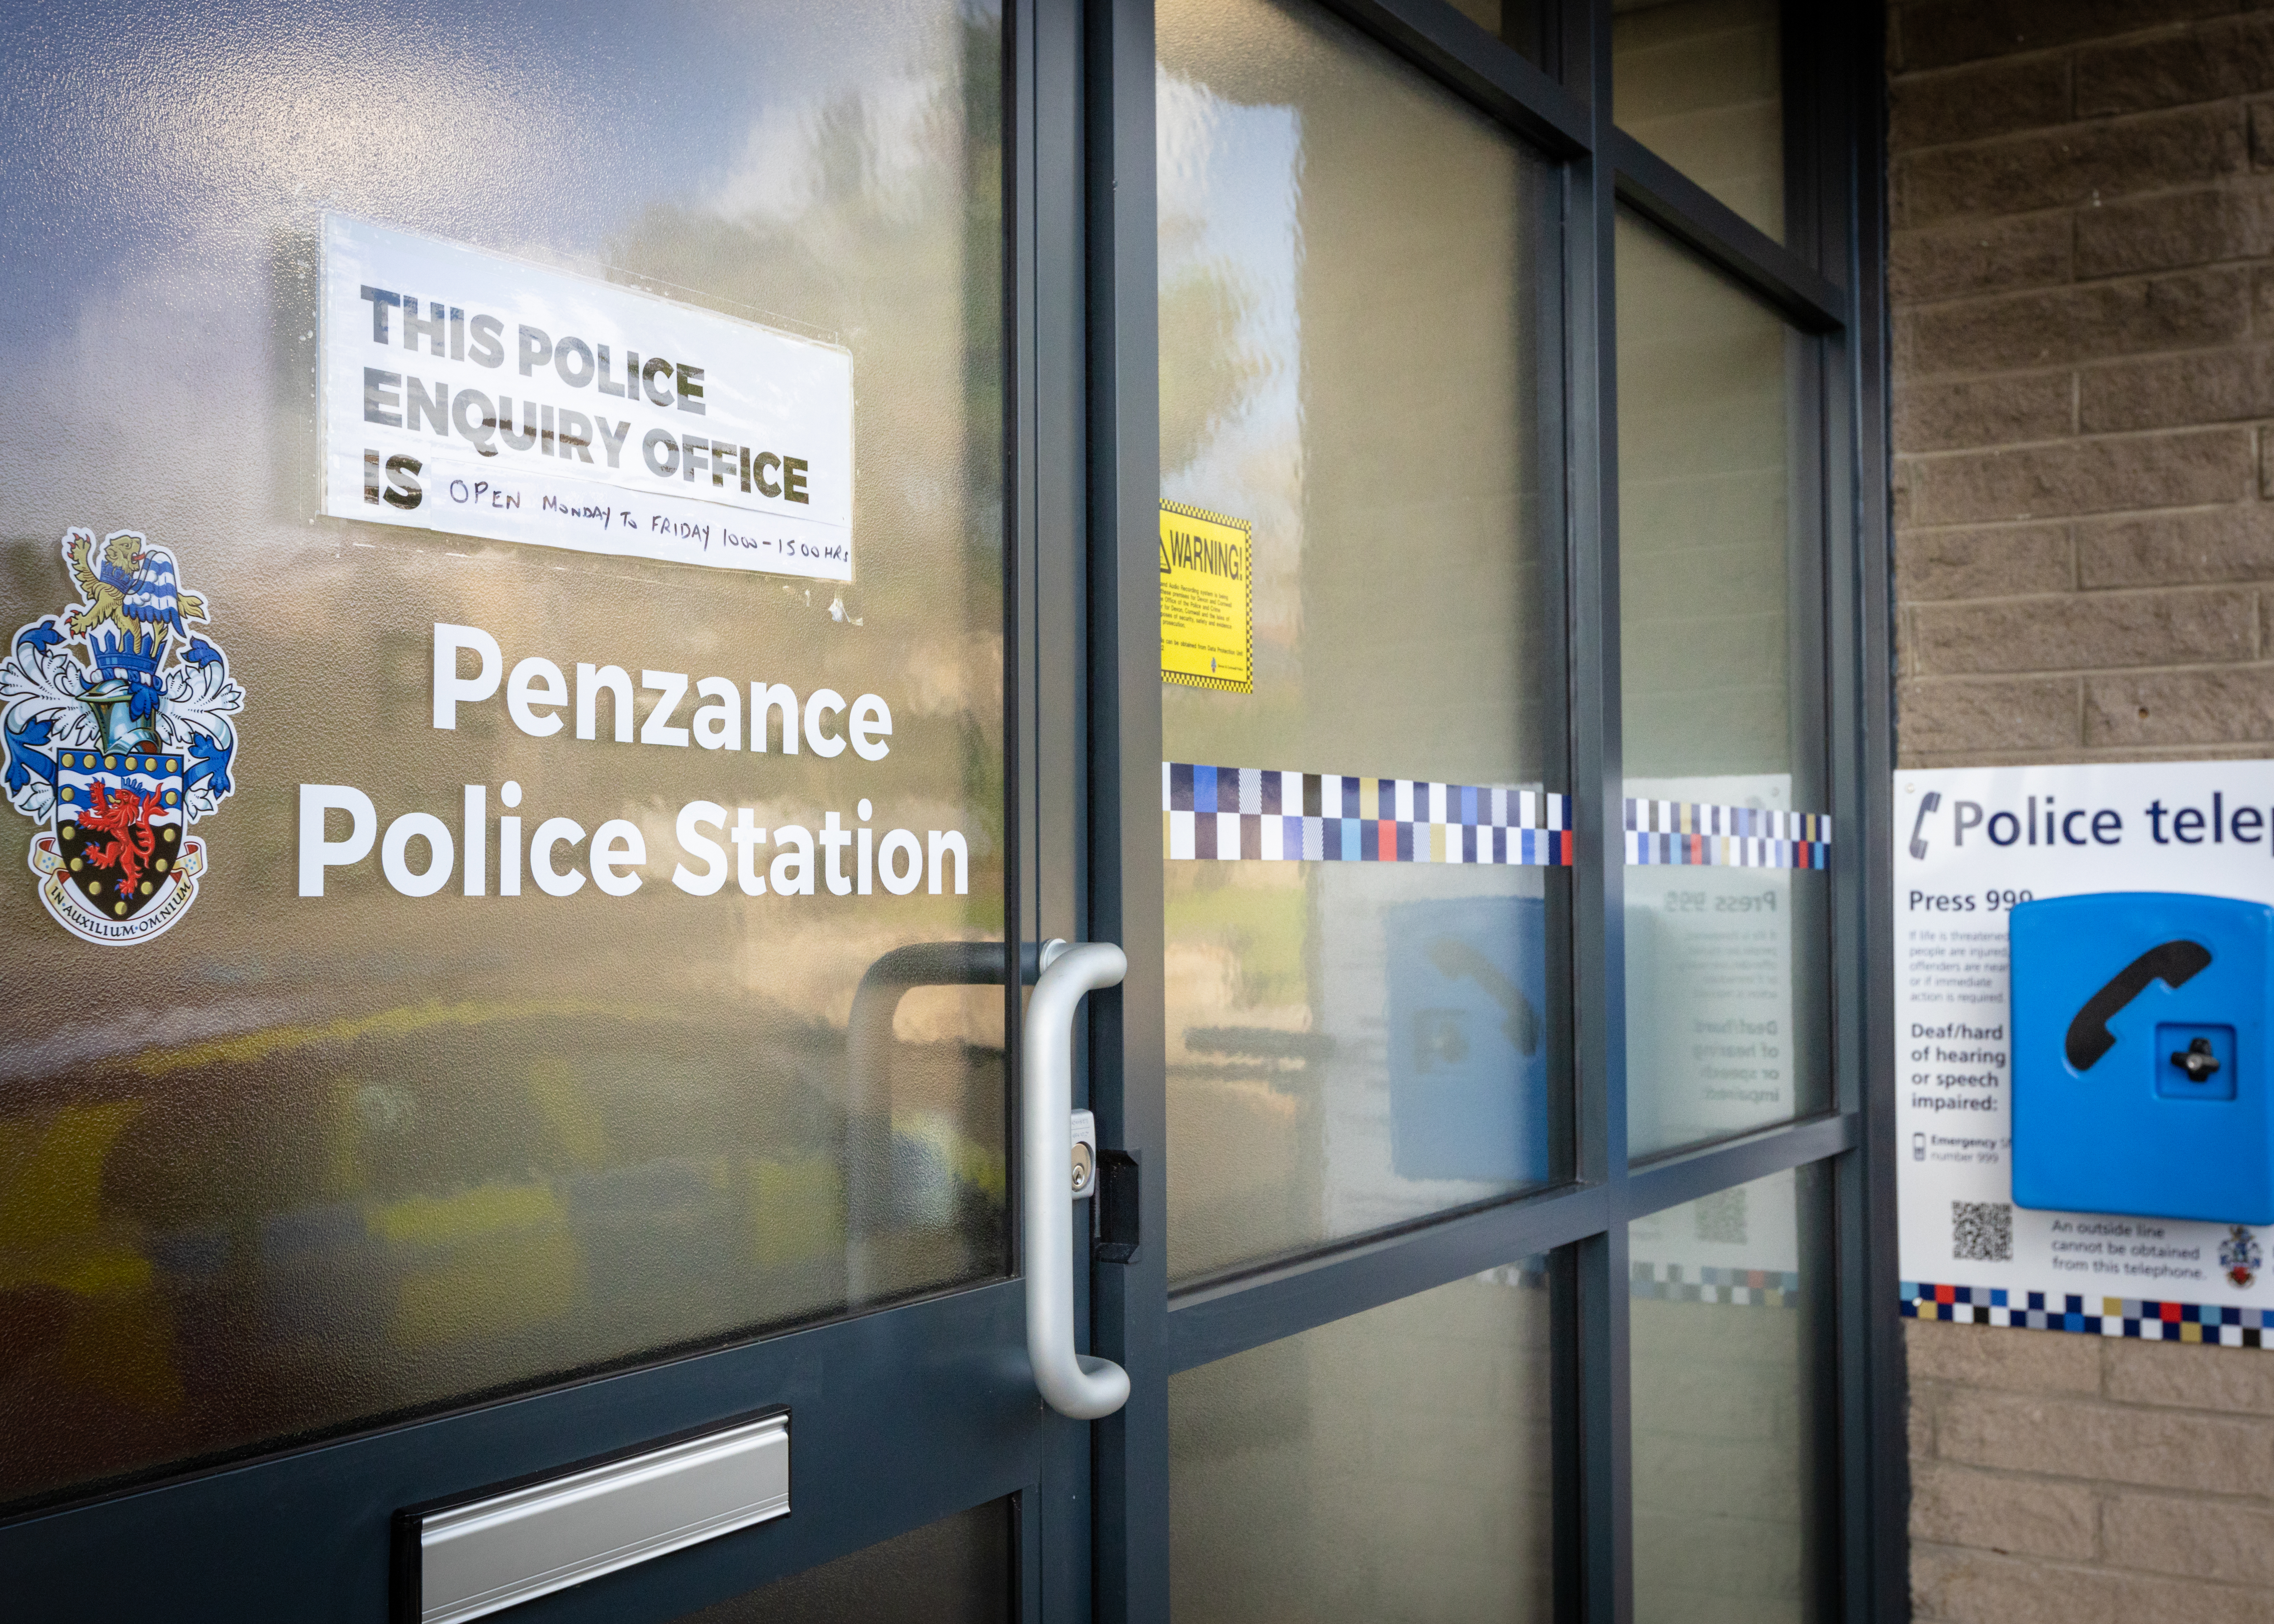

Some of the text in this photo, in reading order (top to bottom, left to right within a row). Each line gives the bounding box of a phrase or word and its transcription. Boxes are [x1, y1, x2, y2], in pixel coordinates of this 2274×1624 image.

[361, 284, 706, 415] THIS POLICE
[363, 367, 809, 504] ENQUIRY OFFICE
[364, 450, 423, 510] IS
[450, 480, 520, 509] OPEN
[652, 516, 709, 551] FRIDAY
[1170, 529, 1243, 581] WARNING!
[433, 622, 892, 761] Penzance
[1954, 791, 2274, 857] Police tele
[299, 780, 968, 897] Police Station
[52, 886, 64, 905] IN
[1910, 890, 1976, 911] Press
[1911, 1023, 2002, 1040] Deaf/hard
[1911, 1046, 2006, 1068] of hearing
[1911, 1071, 1999, 1090] or speech
[1912, 1093, 1997, 1113] impaired:
[1931, 1134, 1997, 1150] Emergency
[2052, 1220, 2165, 1239] An outside line
[2051, 1240, 2200, 1260] cannot be obtained
[2052, 1256, 2207, 1280] from this telephone.
